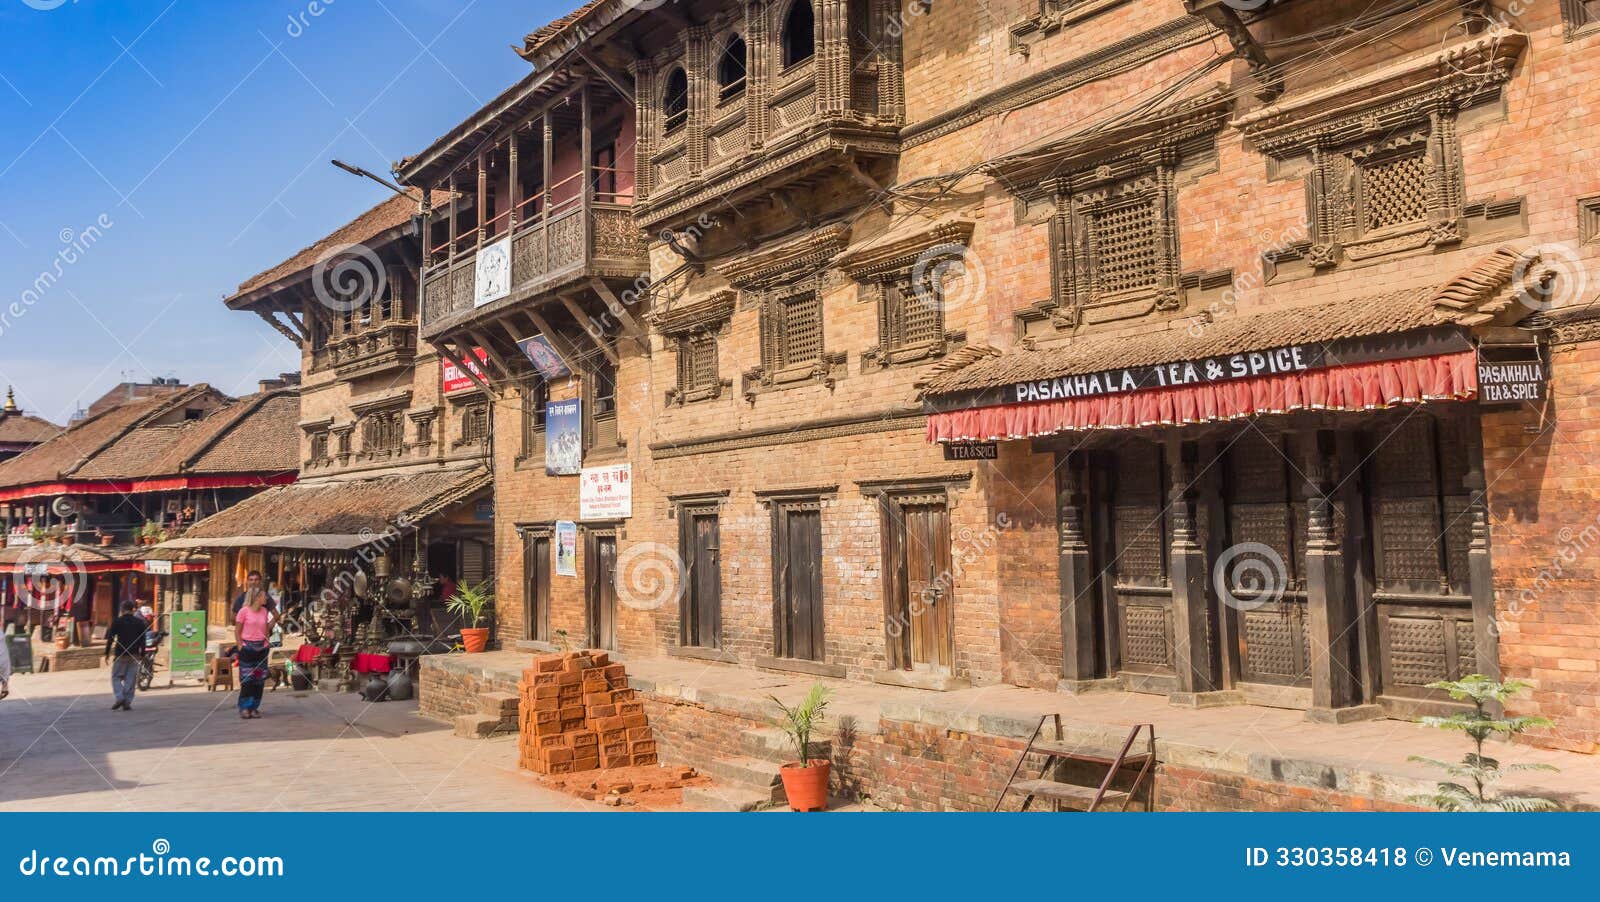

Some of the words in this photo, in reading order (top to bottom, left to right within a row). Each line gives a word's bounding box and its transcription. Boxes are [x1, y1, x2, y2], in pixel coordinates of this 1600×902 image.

[1016, 370, 1137, 402] PASAKHALA
[1154, 363, 1199, 387] TEA
[1206, 359, 1224, 380] &
[1229, 347, 1307, 378] SPICE
[1479, 364, 1543, 384] PASAKHALA
